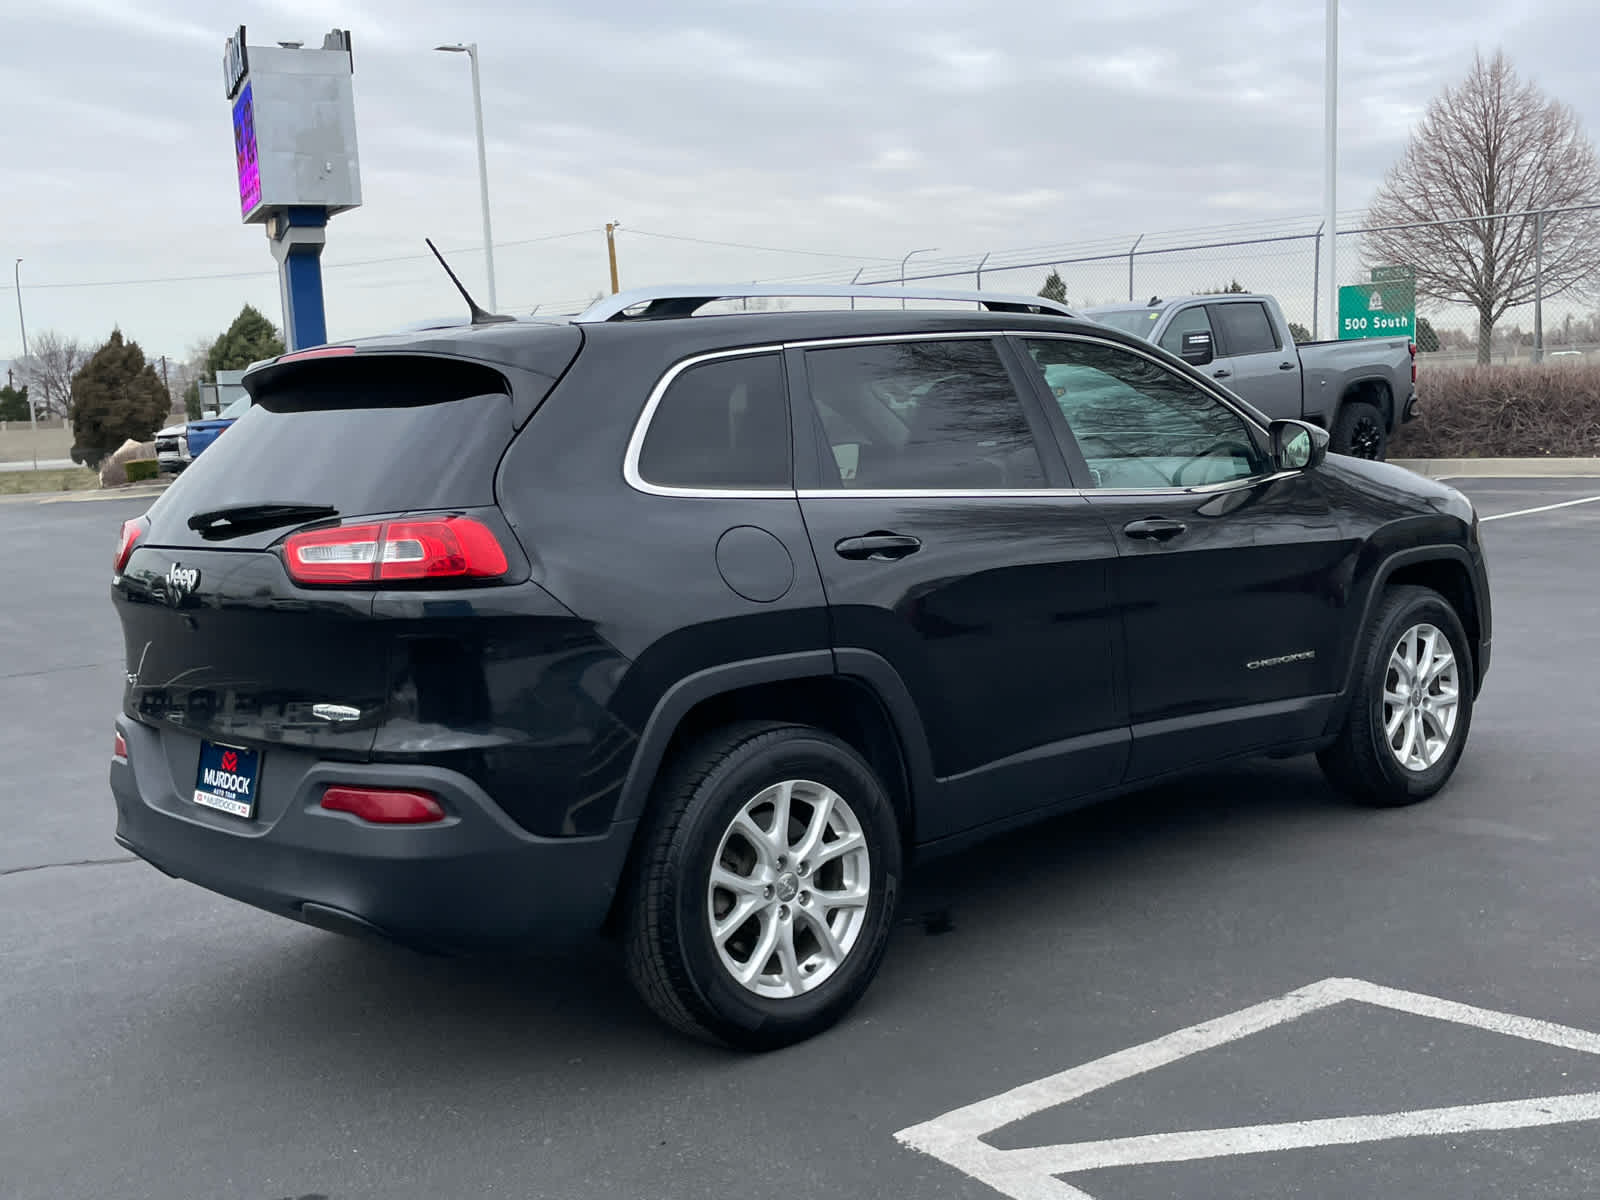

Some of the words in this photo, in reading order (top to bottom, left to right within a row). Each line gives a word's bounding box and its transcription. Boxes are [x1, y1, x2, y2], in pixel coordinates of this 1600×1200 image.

[1344, 317, 1368, 330] 500
[1373, 315, 1409, 329] South
[166, 562, 198, 592] Jeep
[1246, 650, 1316, 669] CHEROKEE
[203, 767, 251, 795] MURDOCK
